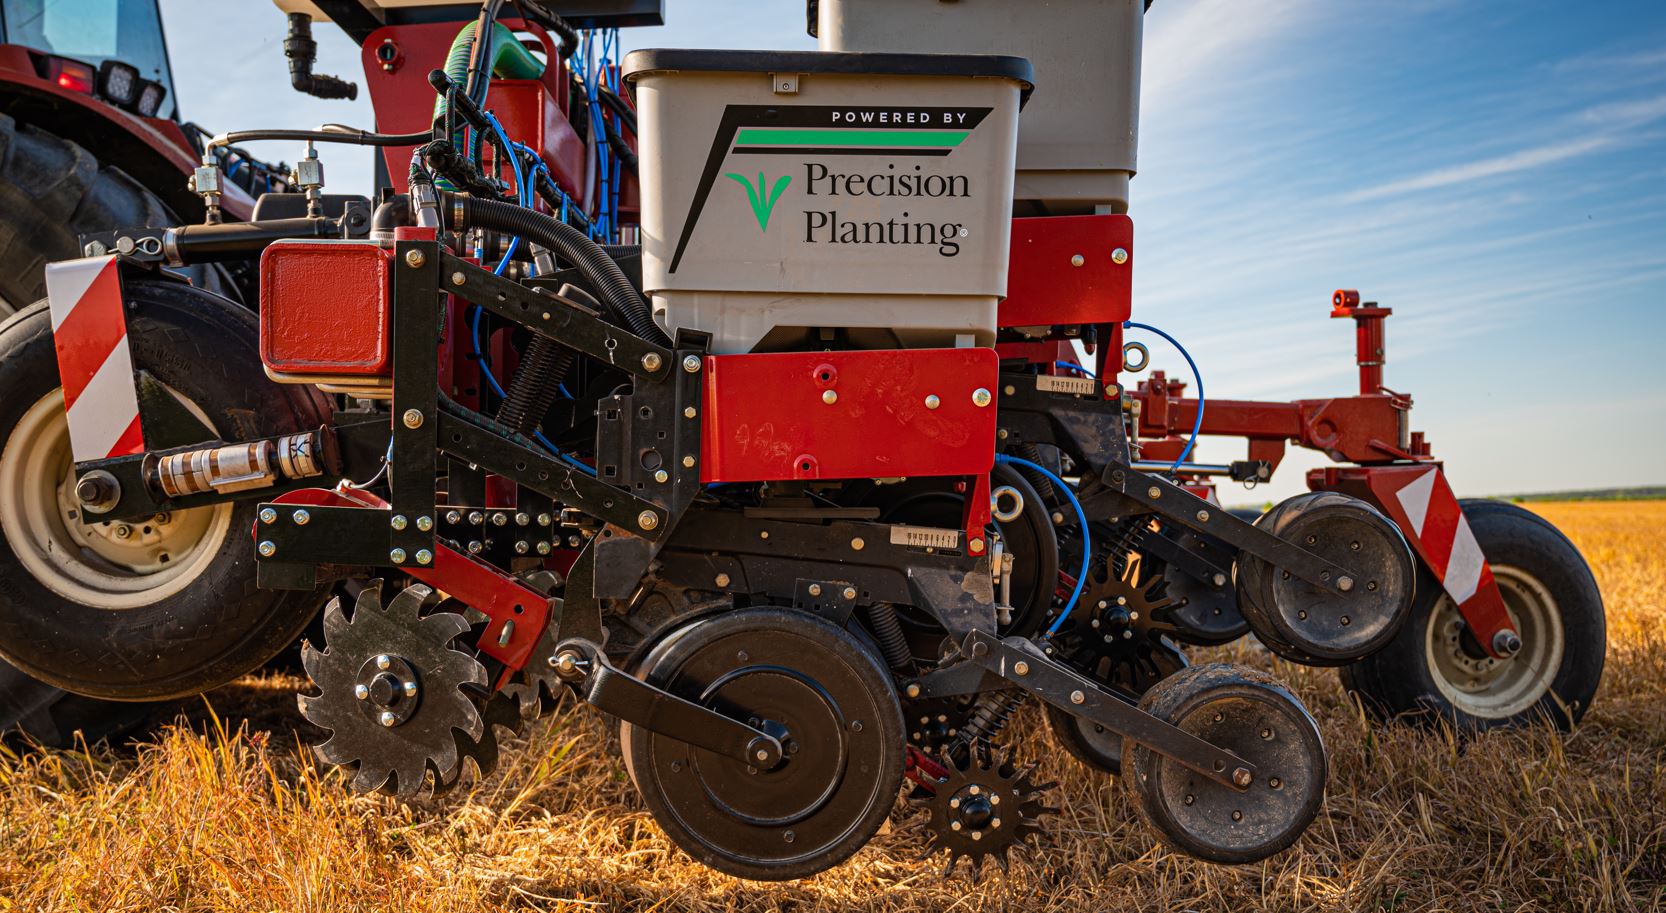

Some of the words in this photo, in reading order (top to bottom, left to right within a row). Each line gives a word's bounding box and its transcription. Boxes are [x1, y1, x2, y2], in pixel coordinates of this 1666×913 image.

[832, 111, 930, 123] POWERED
[943, 112, 967, 124] BY
[803, 163, 971, 197] Precision
